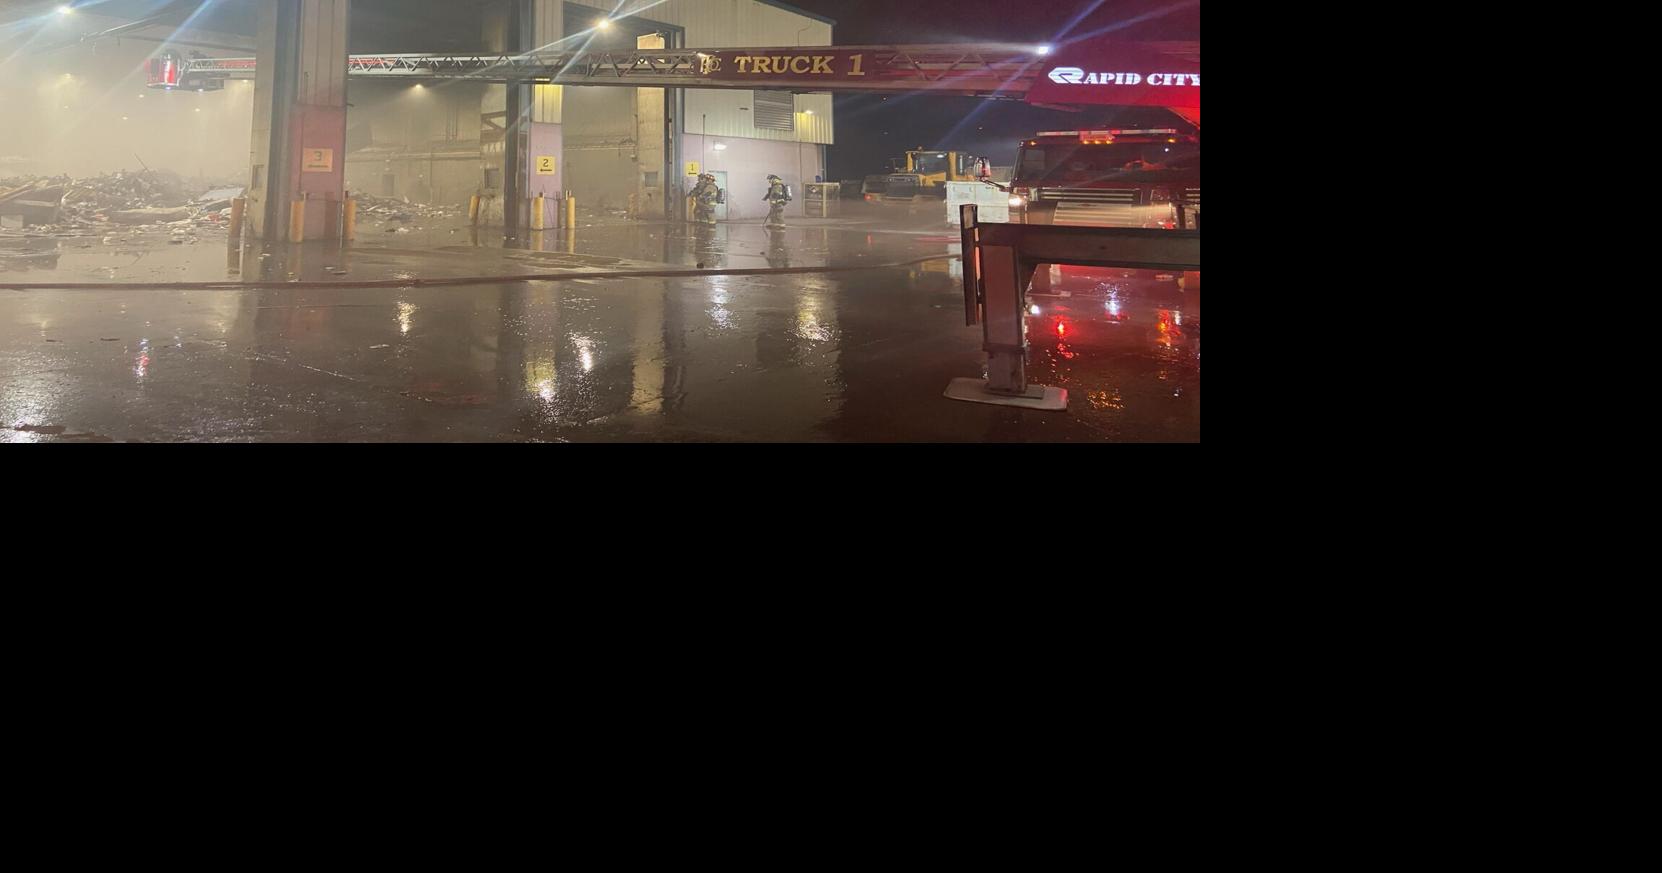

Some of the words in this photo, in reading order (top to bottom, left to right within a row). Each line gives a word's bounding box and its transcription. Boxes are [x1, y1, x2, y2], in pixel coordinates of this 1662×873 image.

[734, 55, 835, 74] TRUCK
[847, 54, 865, 76] 1
[1048, 67, 1142, 85] RAPID
[1146, 73, 1200, 87] CITY
[313, 150, 323, 161] 3
[542, 158, 549, 168] 2
